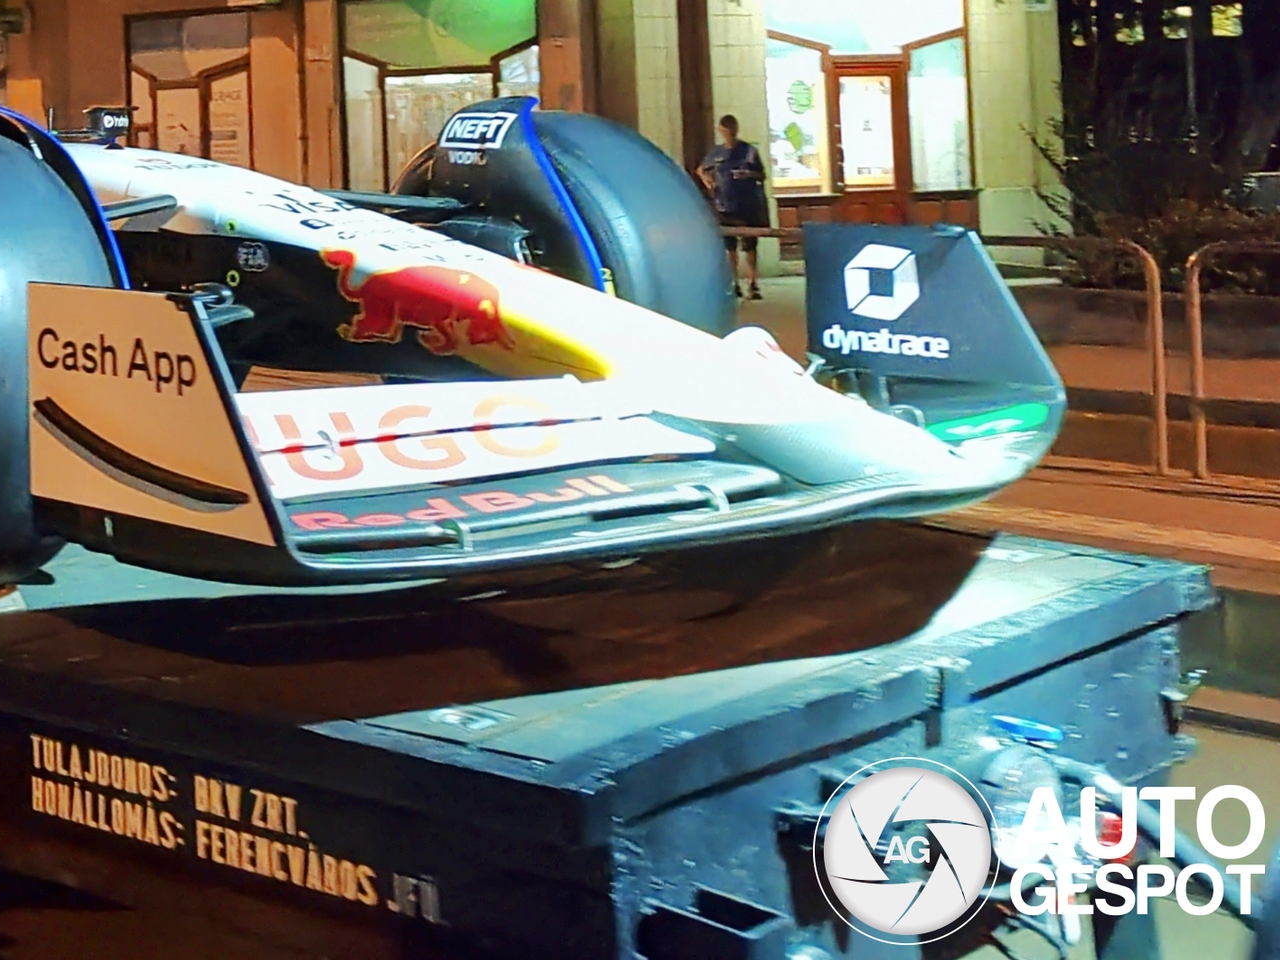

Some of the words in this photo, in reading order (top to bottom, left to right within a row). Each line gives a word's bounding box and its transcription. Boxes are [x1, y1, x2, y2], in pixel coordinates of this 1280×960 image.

[448, 118, 505, 139] NEFT
[37, 327, 119, 377] Cash
[127, 337, 197, 396] App
[823, 324, 950, 359] dynatrace
[243, 393, 562, 487] UGO
[290, 498, 467, 532] Red
[461, 474, 635, 514] Bull
[30, 733, 178, 802] TULAJDONOS:
[195, 819, 379, 907] FERENCVÁROS
